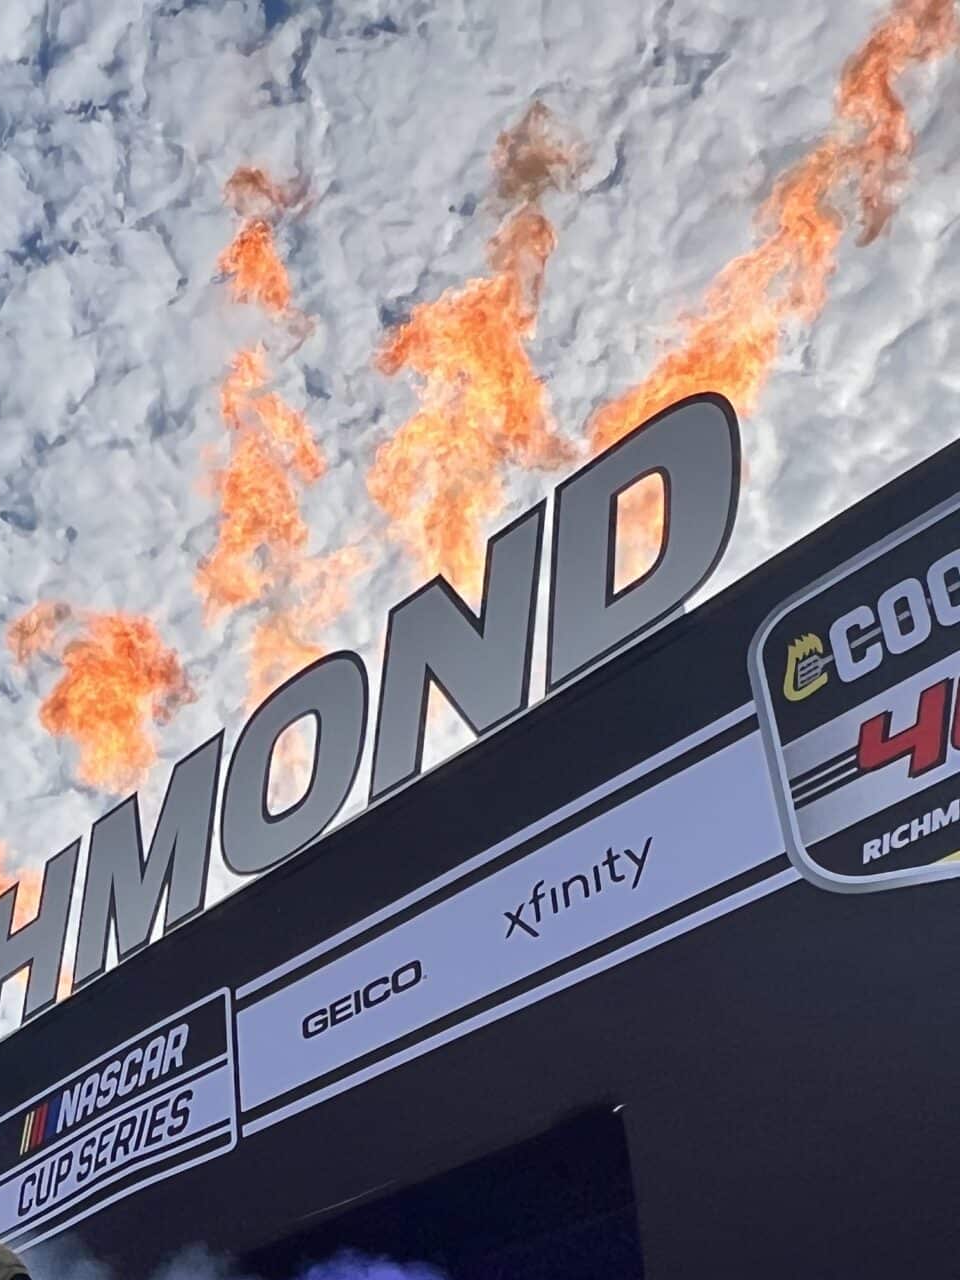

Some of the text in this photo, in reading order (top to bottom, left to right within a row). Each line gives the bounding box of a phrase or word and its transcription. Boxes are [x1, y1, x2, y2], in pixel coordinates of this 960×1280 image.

[856, 674, 960, 779] 4
[862, 799, 960, 864] RICHM
[503, 836, 653, 939] xfinity
[302, 960, 422, 1039] GEICO
[55, 1023, 190, 1134] NASCAR
[17, 1089, 194, 1218] CUP SERIES
